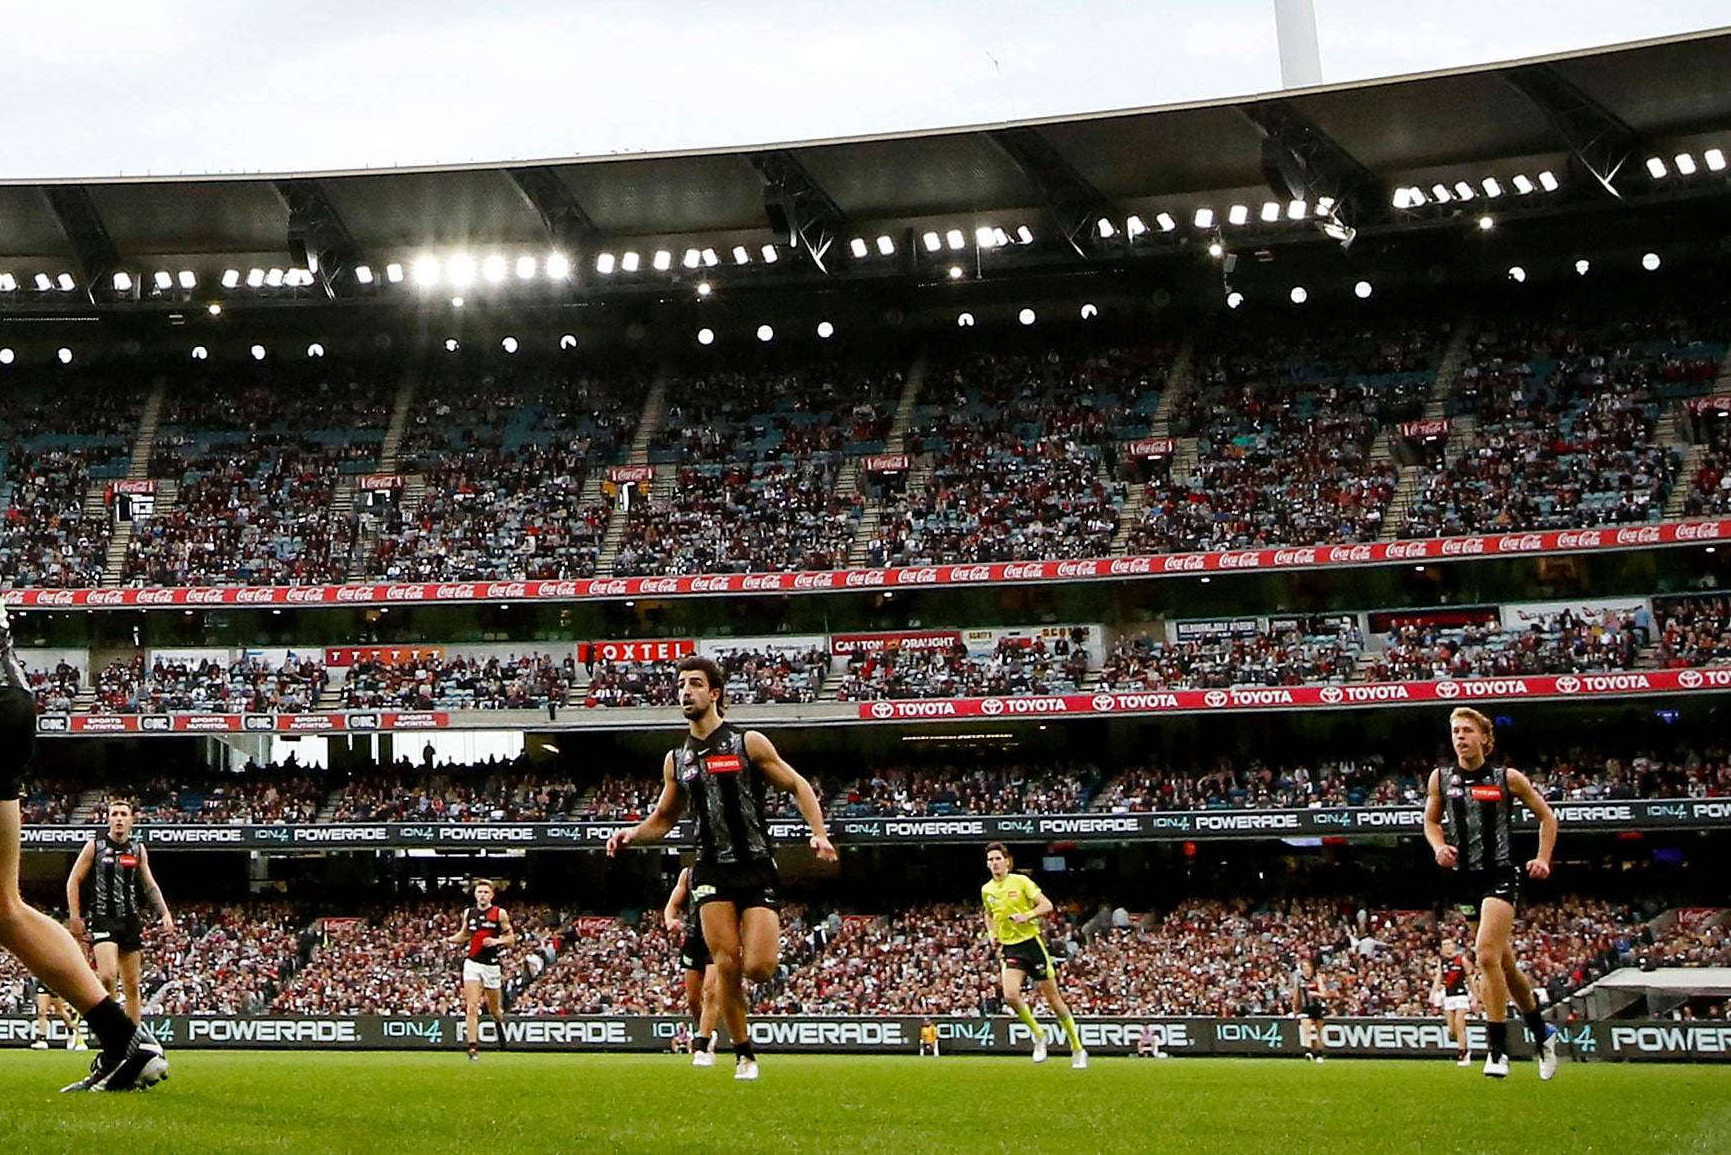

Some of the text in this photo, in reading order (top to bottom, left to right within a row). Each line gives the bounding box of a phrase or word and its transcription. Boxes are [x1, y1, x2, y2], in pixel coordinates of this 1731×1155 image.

[1468, 680, 1526, 695] TOYOTA
[1585, 675, 1649, 690] TOYOTA
[1233, 690, 1292, 704] TOYOTA
[1349, 685, 1408, 700] TOYOTA
[898, 702, 954, 716] TOYOTA
[1007, 698, 1066, 712] TOYOTA
[1118, 694, 1178, 709] TOYOTA
